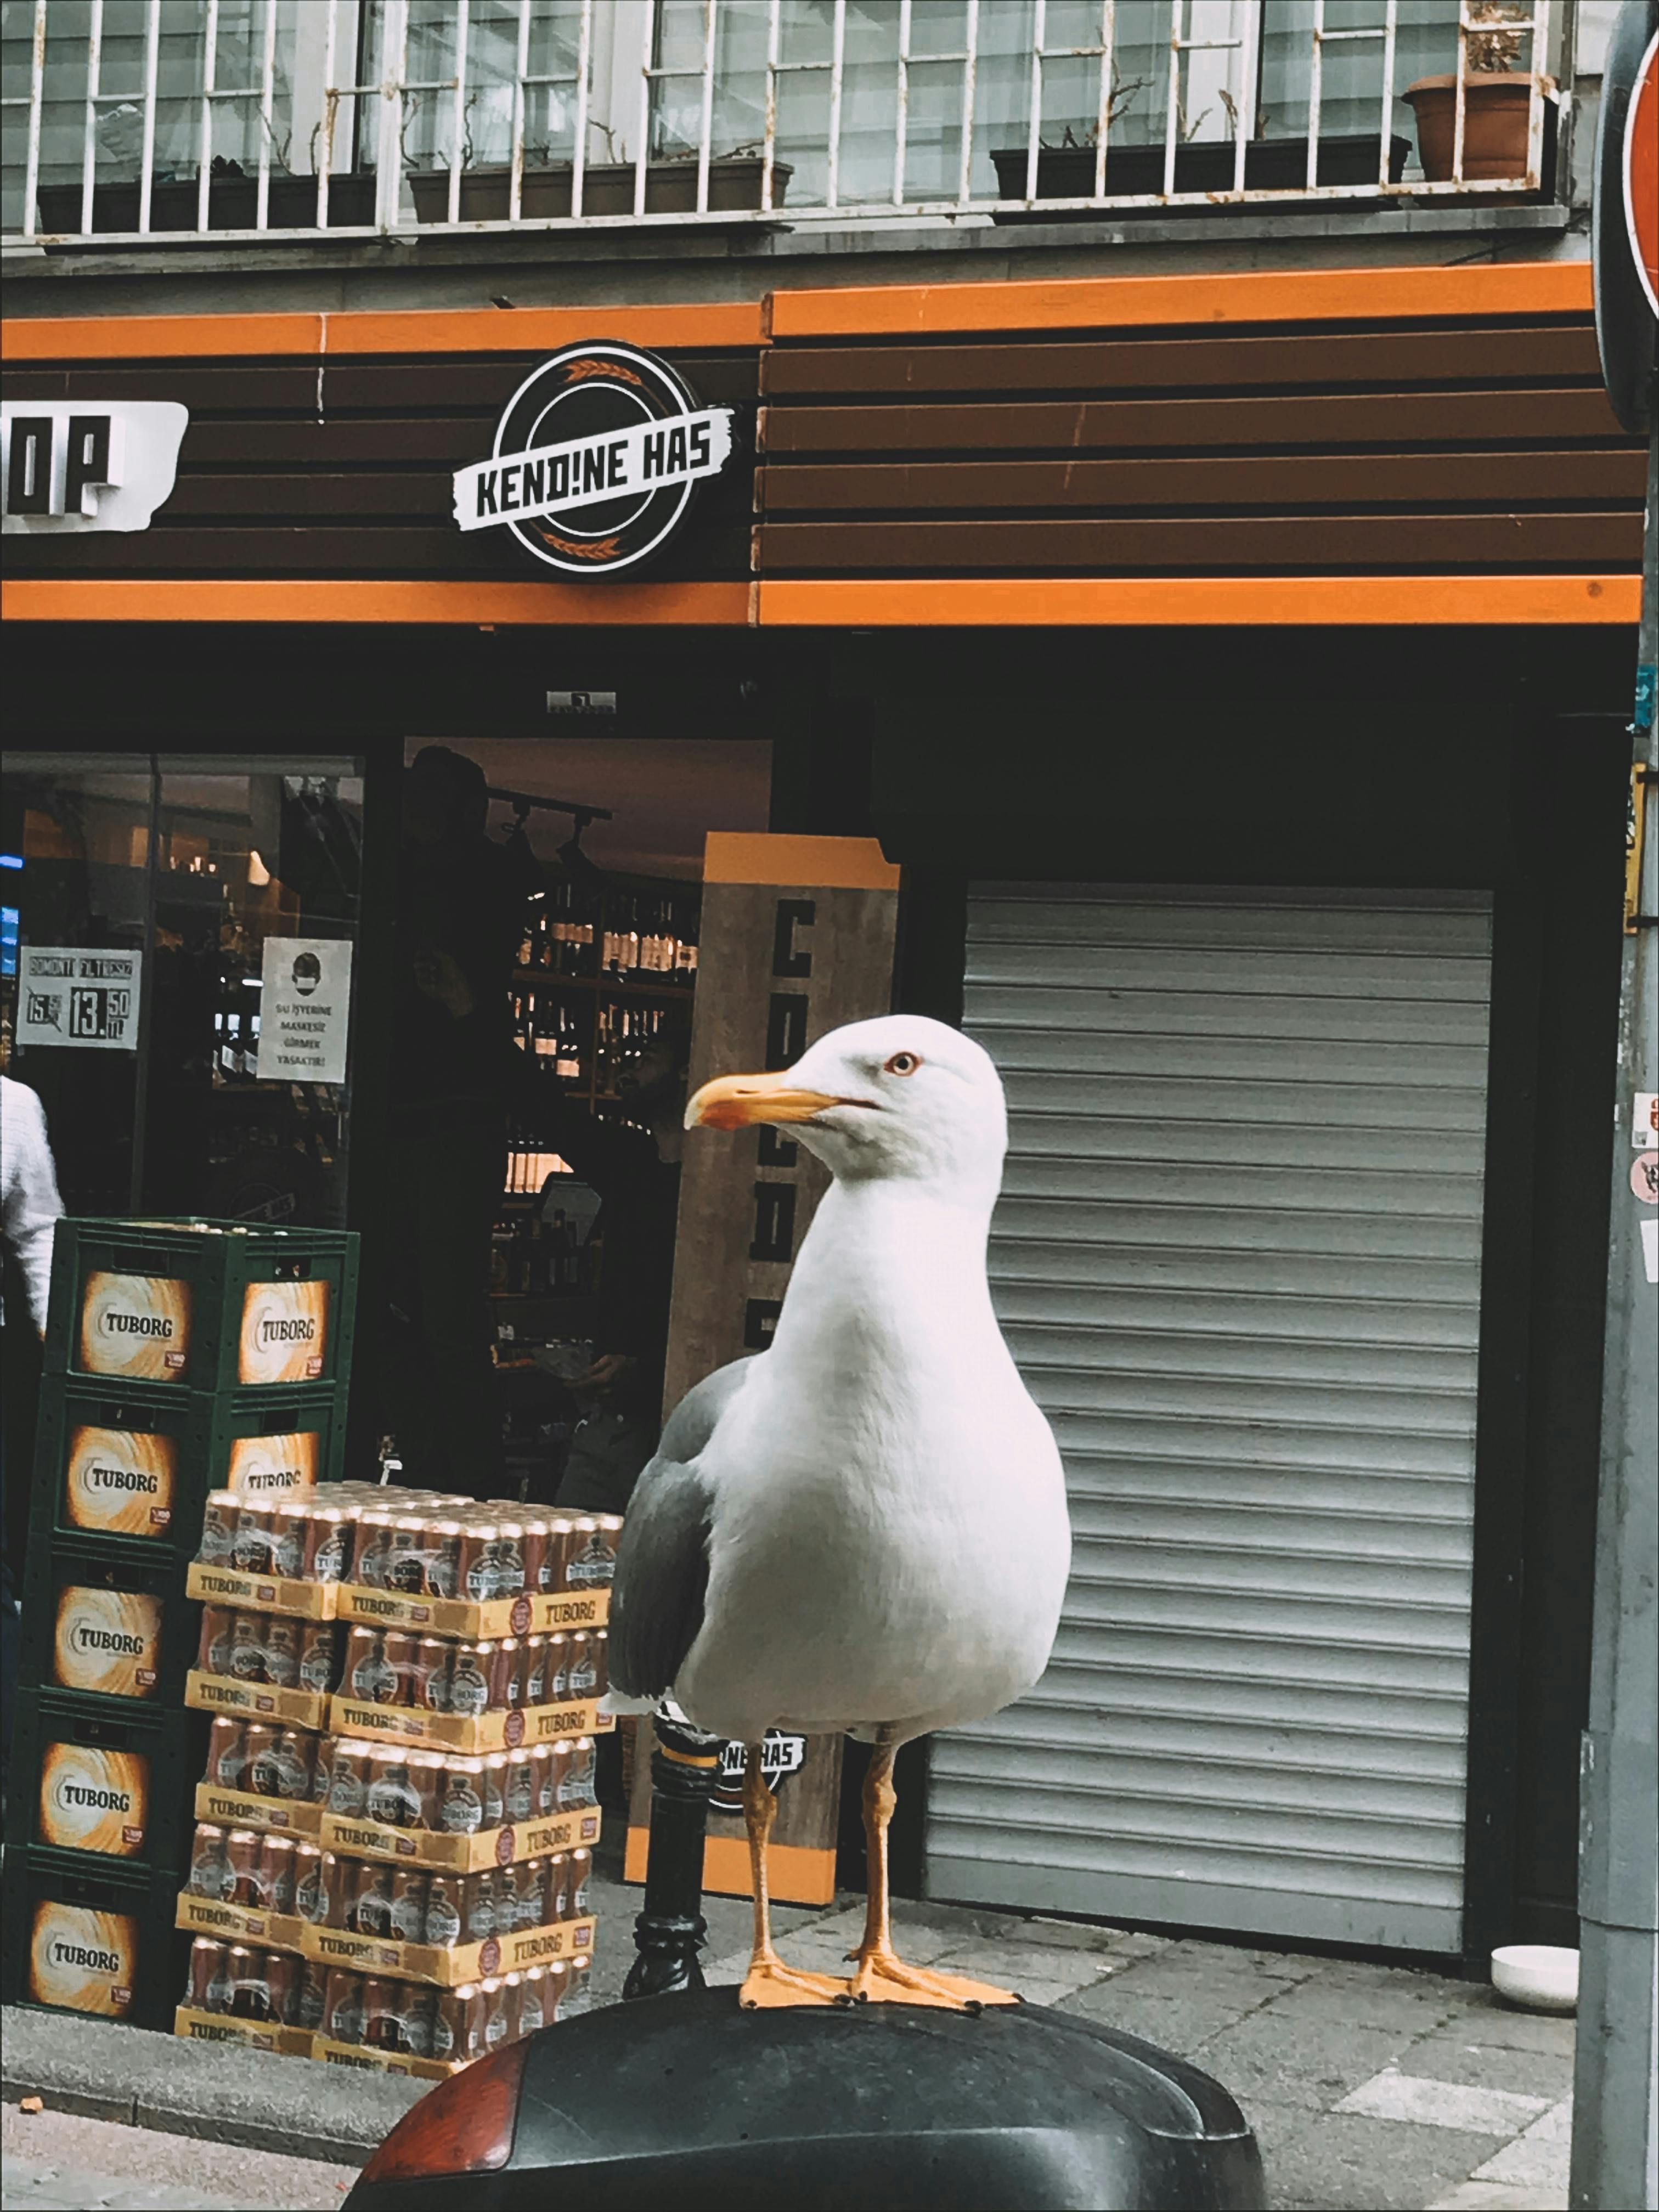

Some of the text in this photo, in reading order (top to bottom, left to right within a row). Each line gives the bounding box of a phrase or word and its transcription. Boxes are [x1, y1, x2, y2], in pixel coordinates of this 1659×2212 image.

[643, 420, 711, 479] HAS
[106, 1313, 173, 1338] TUBORG
[262, 1318, 315, 1342] TUBORG
[92, 1467, 158, 1493] TUBORG
[546, 1600, 596, 1625] TUBORG
[79, 1628, 144, 1655] TUBORG
[538, 1710, 586, 1736] TUBORG
[65, 1785, 130, 1812] TUBORG
[527, 1823, 572, 1852] TUBORG
[55, 1943, 119, 1972] TUBORG
[514, 1933, 563, 1962] TUBORG
